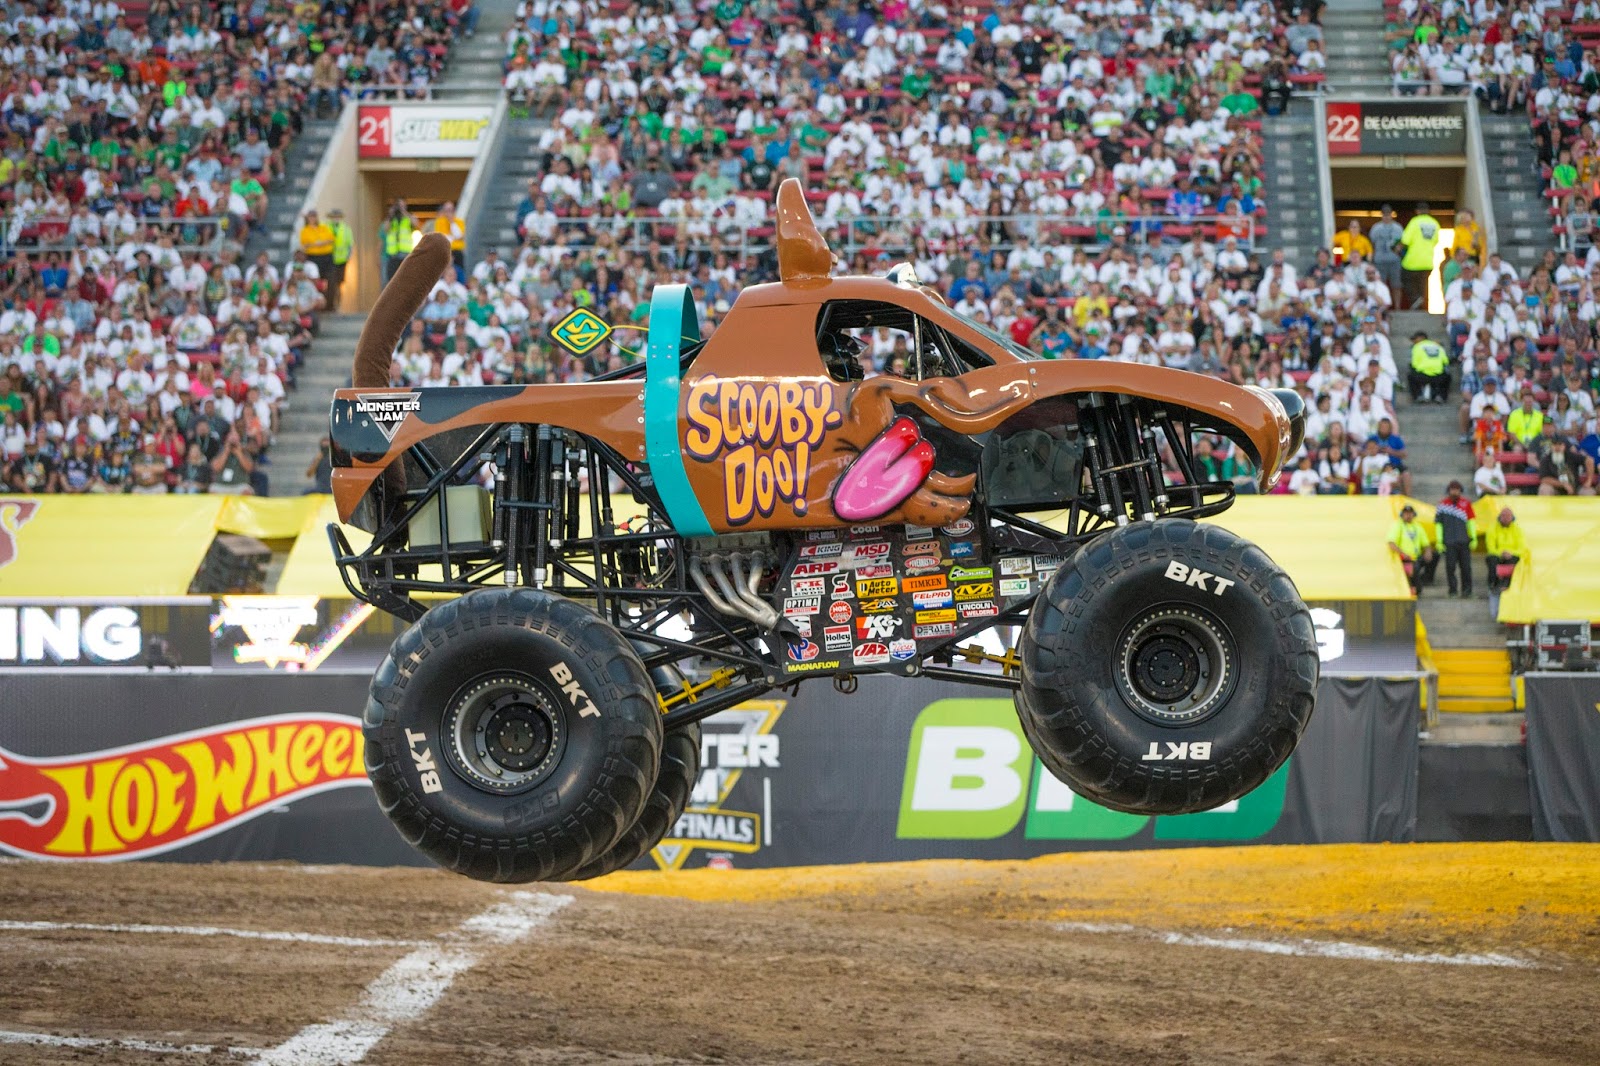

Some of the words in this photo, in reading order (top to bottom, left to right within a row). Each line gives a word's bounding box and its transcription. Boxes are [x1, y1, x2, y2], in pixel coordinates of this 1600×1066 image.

[1328, 116, 1360, 142] 22
[1364, 116, 1380, 130] DE
[359, 117, 390, 146] 21
[397, 117, 489, 143] SUBWAY
[356, 402, 420, 412] MONSTER
[374, 412, 403, 421] JAM
[817, 544, 841, 553] KING
[855, 543, 889, 556] MSD
[793, 562, 838, 575] ARP
[869, 580, 891, 588] Auto
[909, 578, 942, 589] TIMKEN
[1165, 560, 1235, 597] BKT
[867, 586, 896, 596] Meter
[786, 598, 818, 609] OPTIMA
[959, 602, 991, 610] LINCOLN
[863, 614, 903, 639] K&N
[826, 633, 850, 642] Holley
[854, 643, 888, 656] JAZ
[788, 661, 840, 672] MAGNAFLOW
[549, 661, 601, 719] BKT
[1141, 740, 1212, 761] BKT
[404, 728, 444, 795] BKT
[674, 813, 755, 843] FINALS
